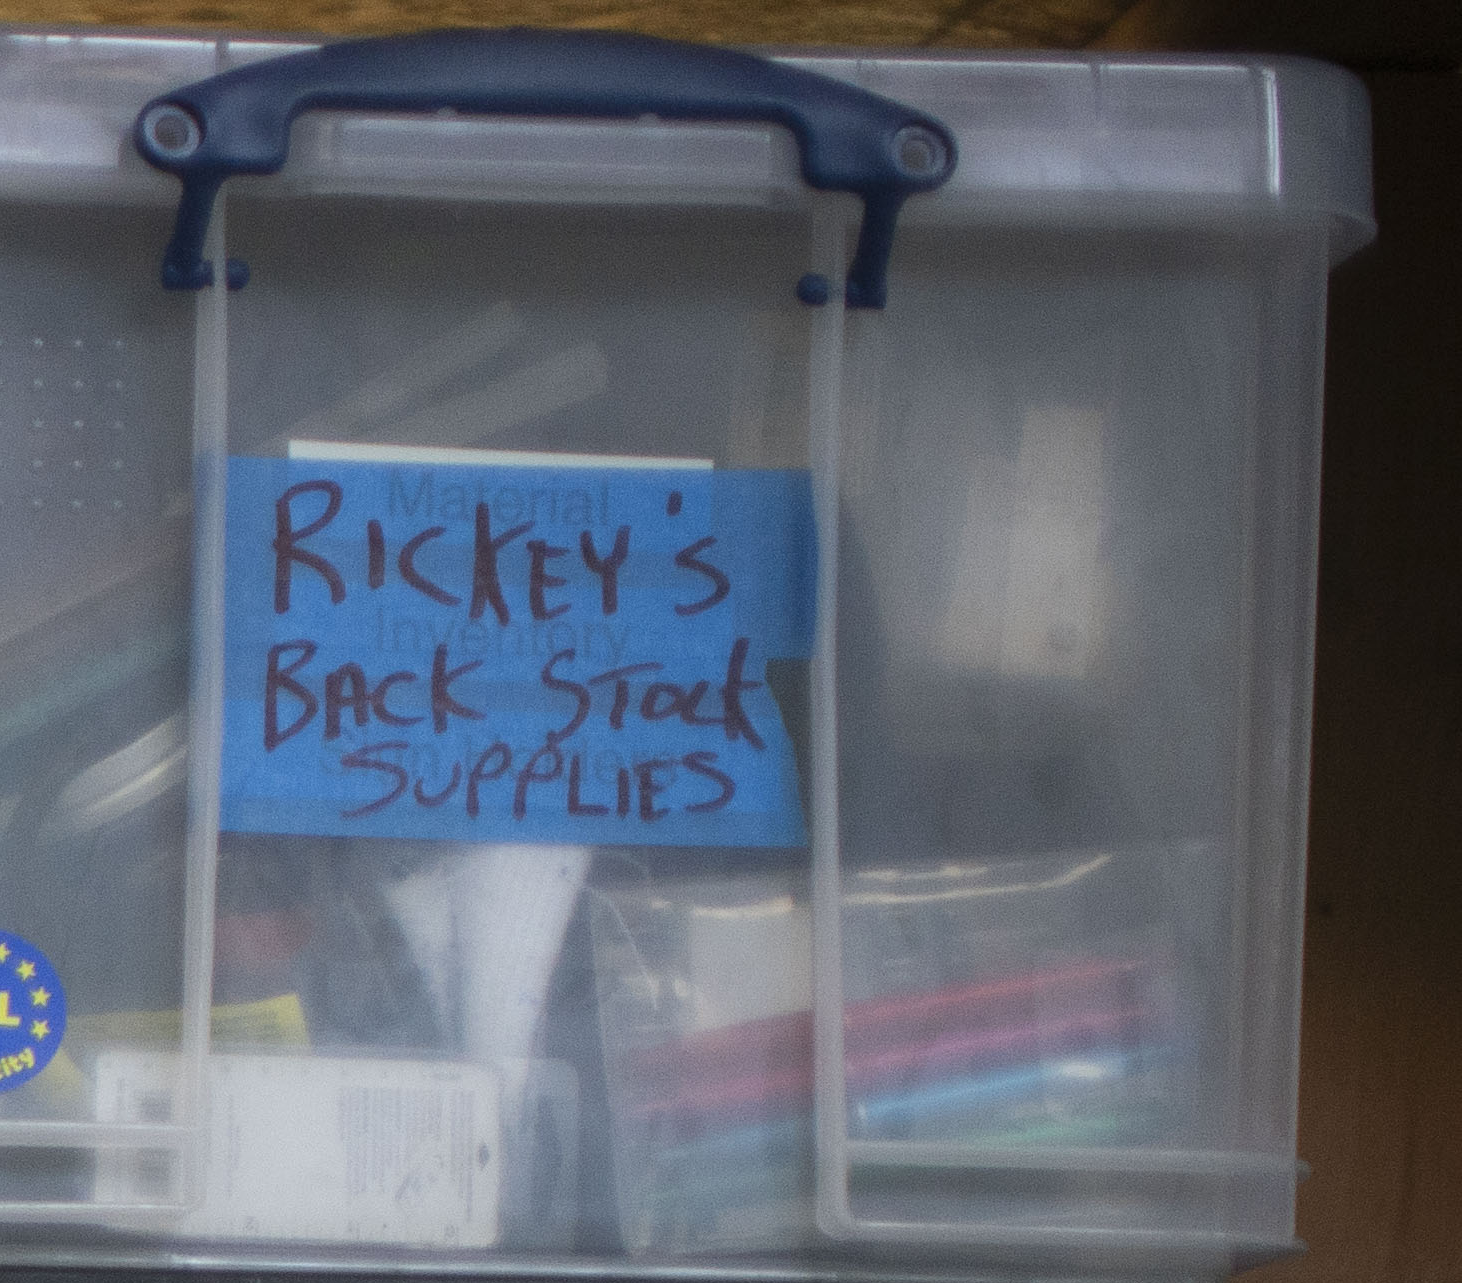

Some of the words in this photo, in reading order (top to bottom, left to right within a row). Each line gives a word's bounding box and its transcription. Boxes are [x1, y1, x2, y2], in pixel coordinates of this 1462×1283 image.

[272, 479, 732, 628] RICKEY'S
[263, 639, 488, 752] BACK
[339, 734, 737, 823] SUPPLIES
